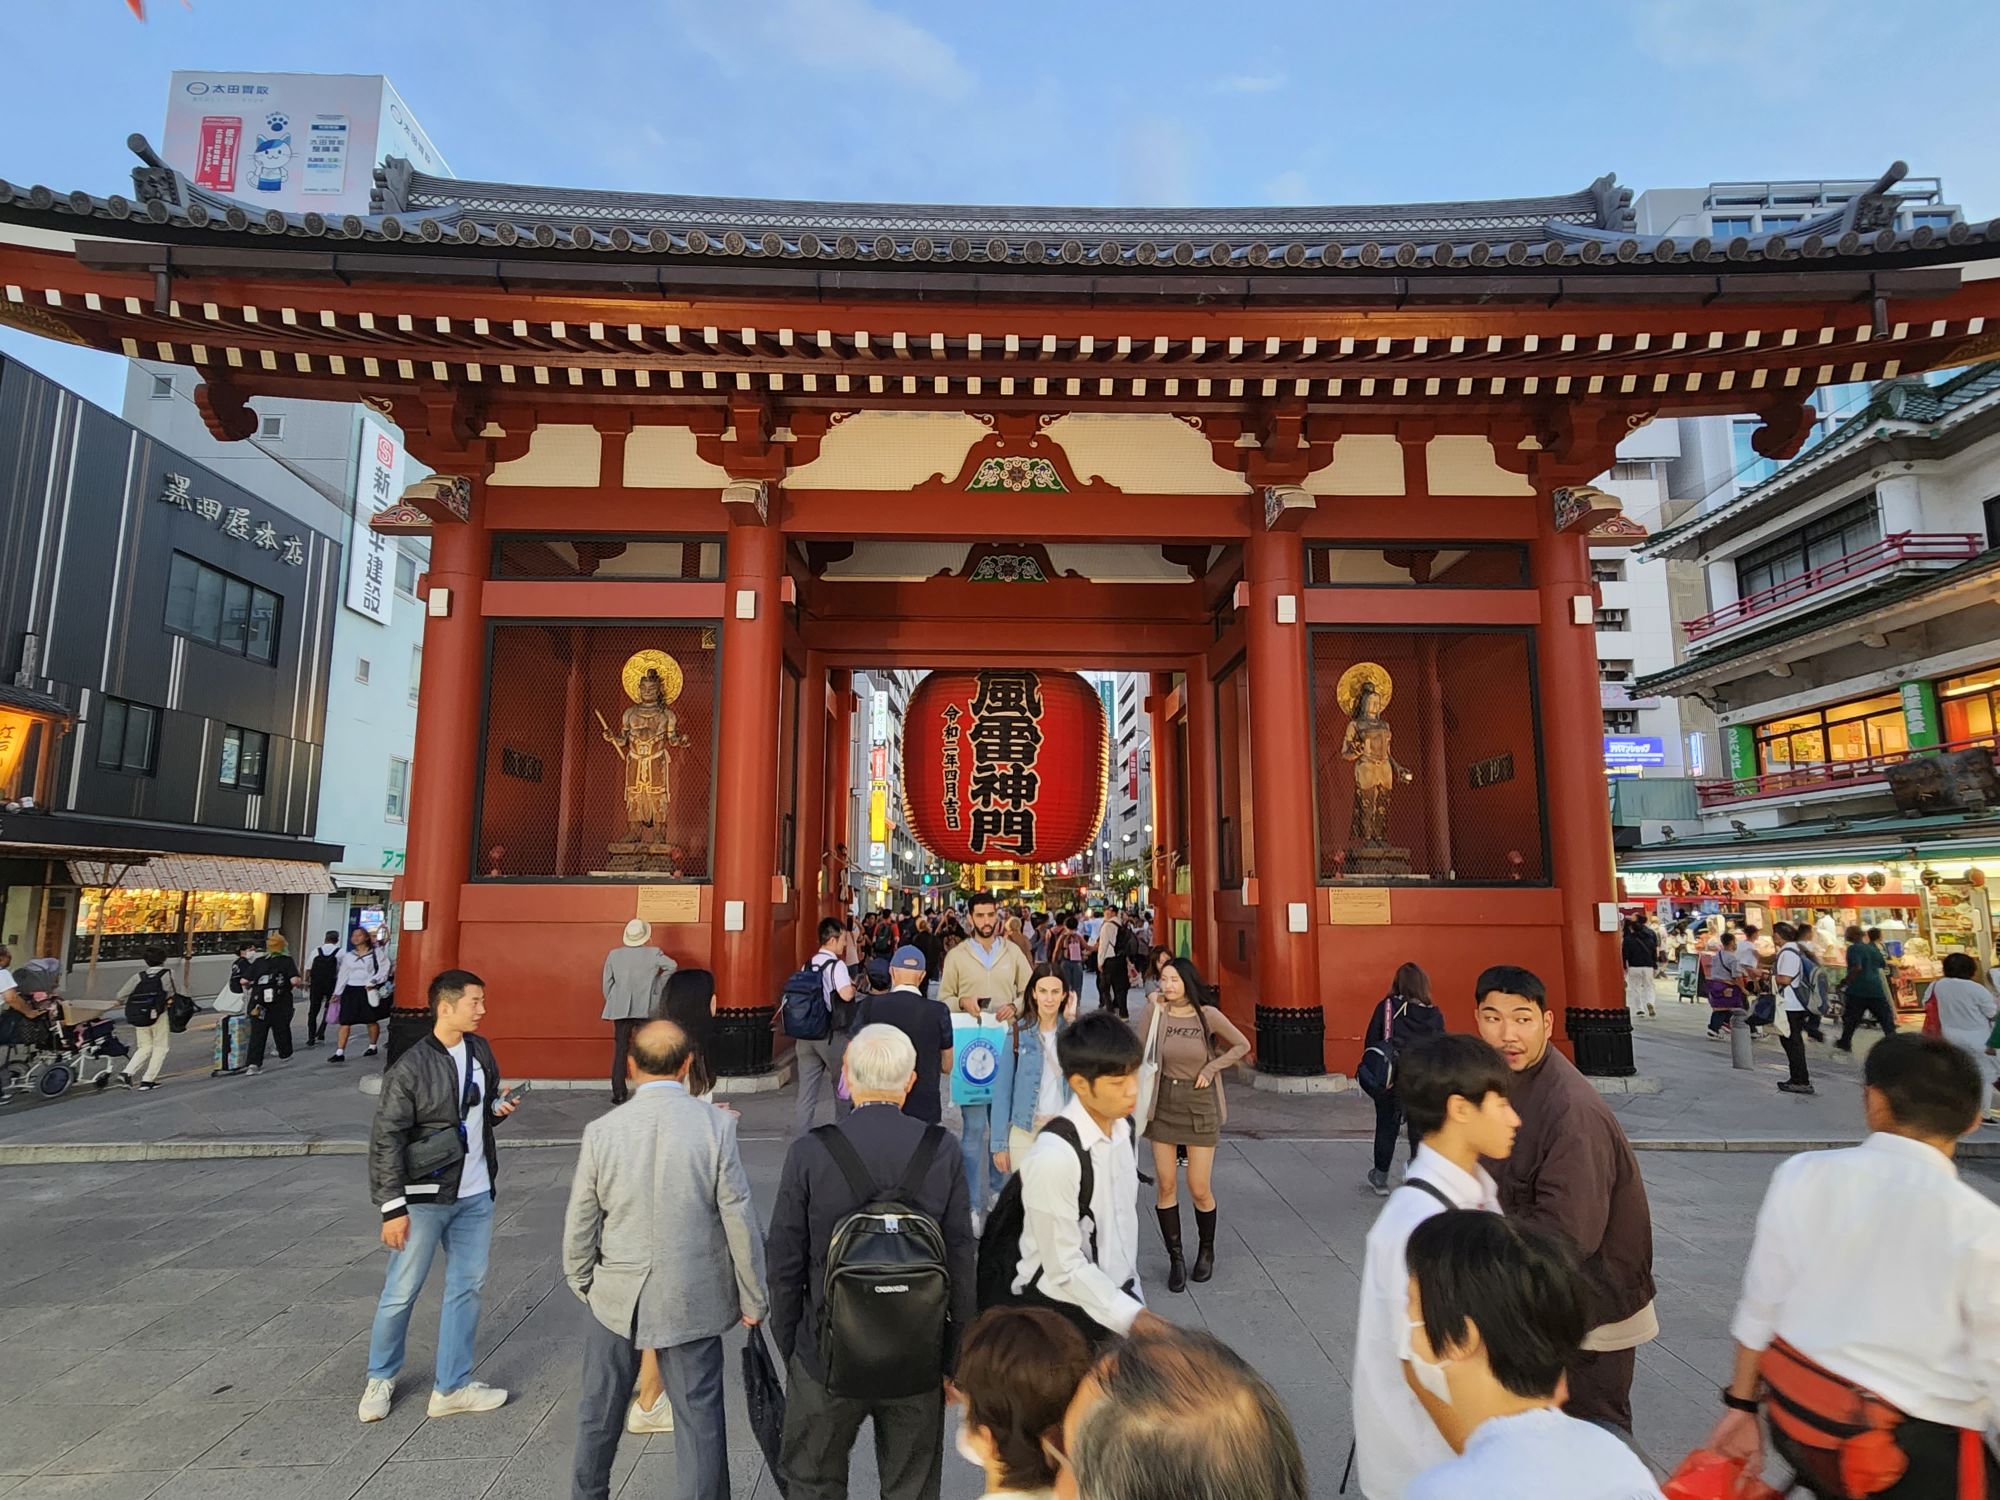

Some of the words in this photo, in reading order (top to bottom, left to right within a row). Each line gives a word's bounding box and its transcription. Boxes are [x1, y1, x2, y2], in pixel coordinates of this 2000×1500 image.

[940, 702, 963, 831] 令和二年四月吉日
[967, 670, 1044, 857] 風雷神門
